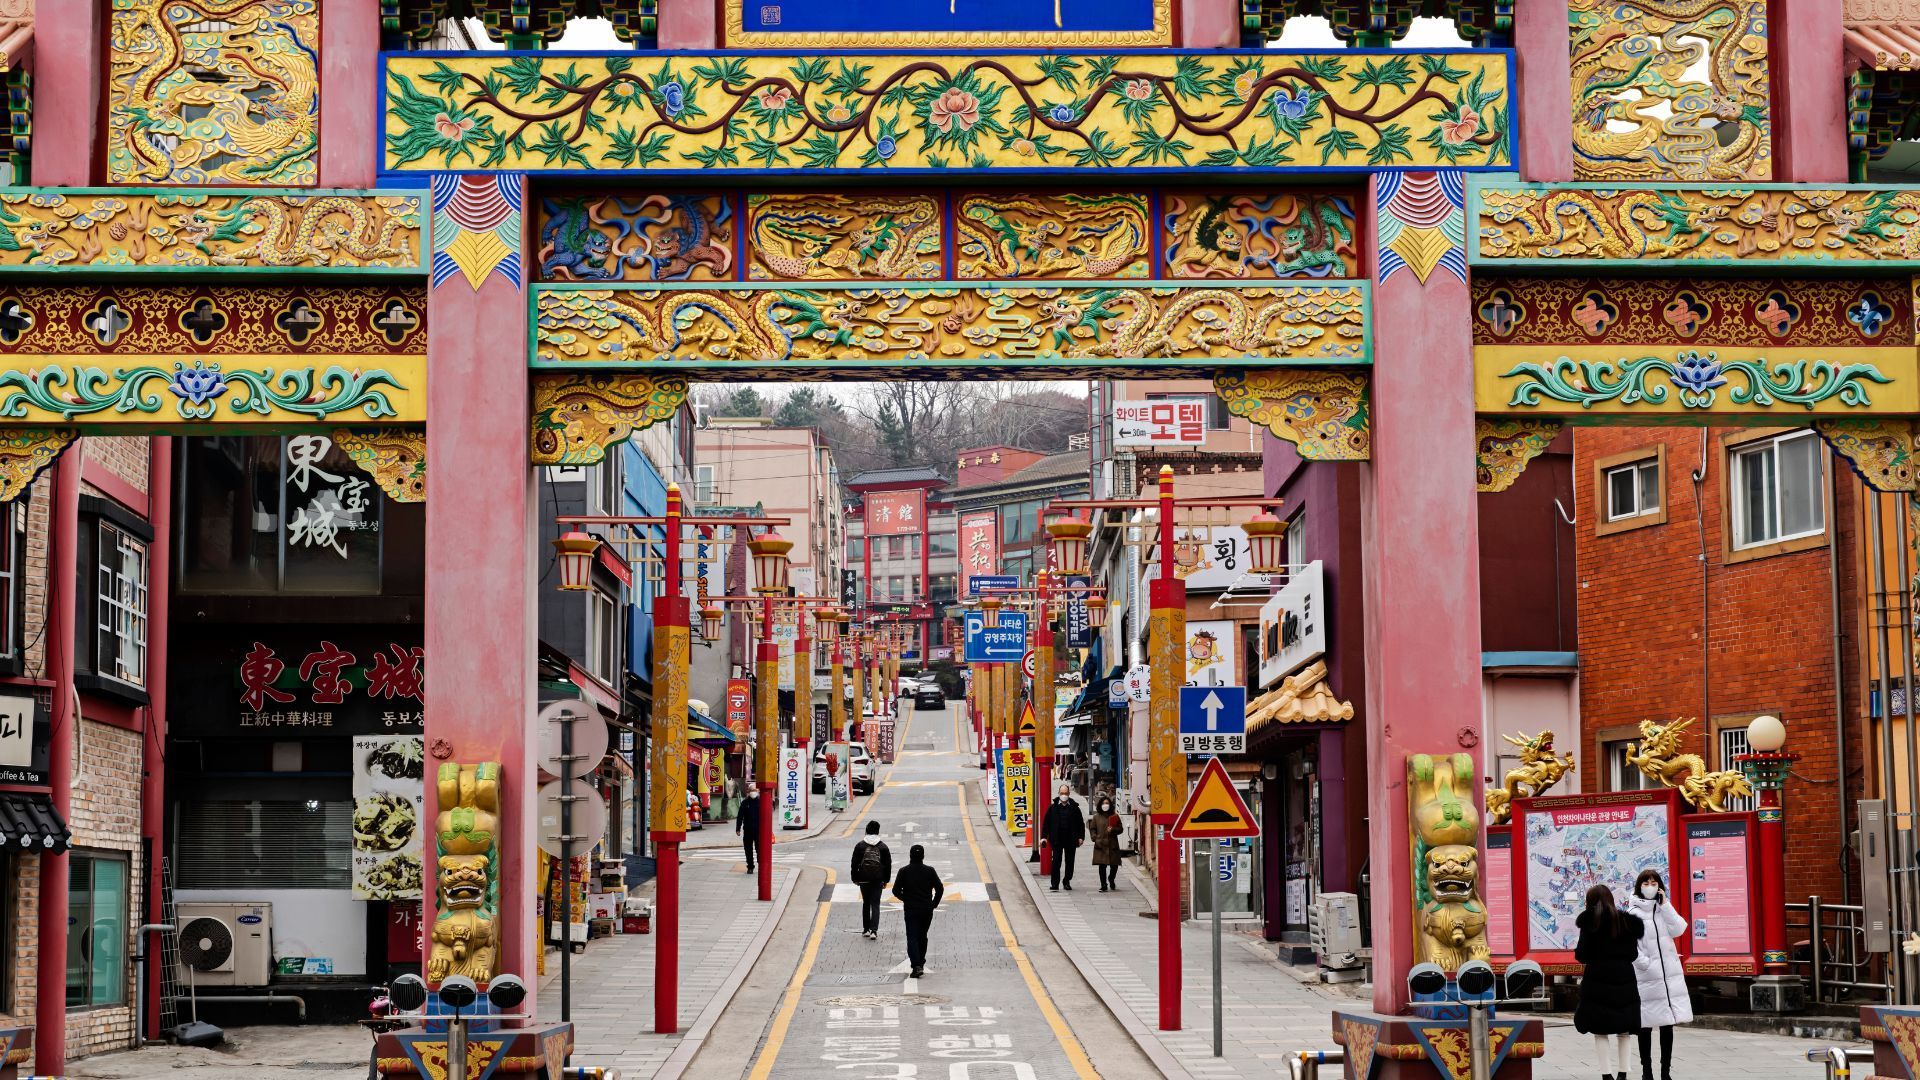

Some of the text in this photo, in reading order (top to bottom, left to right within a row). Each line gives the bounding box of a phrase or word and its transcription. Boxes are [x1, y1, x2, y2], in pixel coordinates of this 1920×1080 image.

[1116, 404, 1203, 441] 화이트 모텔
[347, 520, 379, 532] 동보성
[968, 527, 991, 577] 共和
[1069, 596, 1080, 641] COFFEE
[967, 618, 983, 643] P
[984, 633, 1023, 644] 공영주차장
[240, 711, 333, 727] 正統中華料理
[381, 711, 424, 727] 동보성
[356, 741, 378, 750] 짜장면
[1182, 735, 1243, 751] 일방통행
[18, 772, 25, 781] &
[27, 772, 39, 782] Tea
[787, 771, 799, 804] 오락실
[1011, 778, 1029, 829] 사격장
[1556, 810, 1630, 824] 인천차이나타운 관광 안내도
